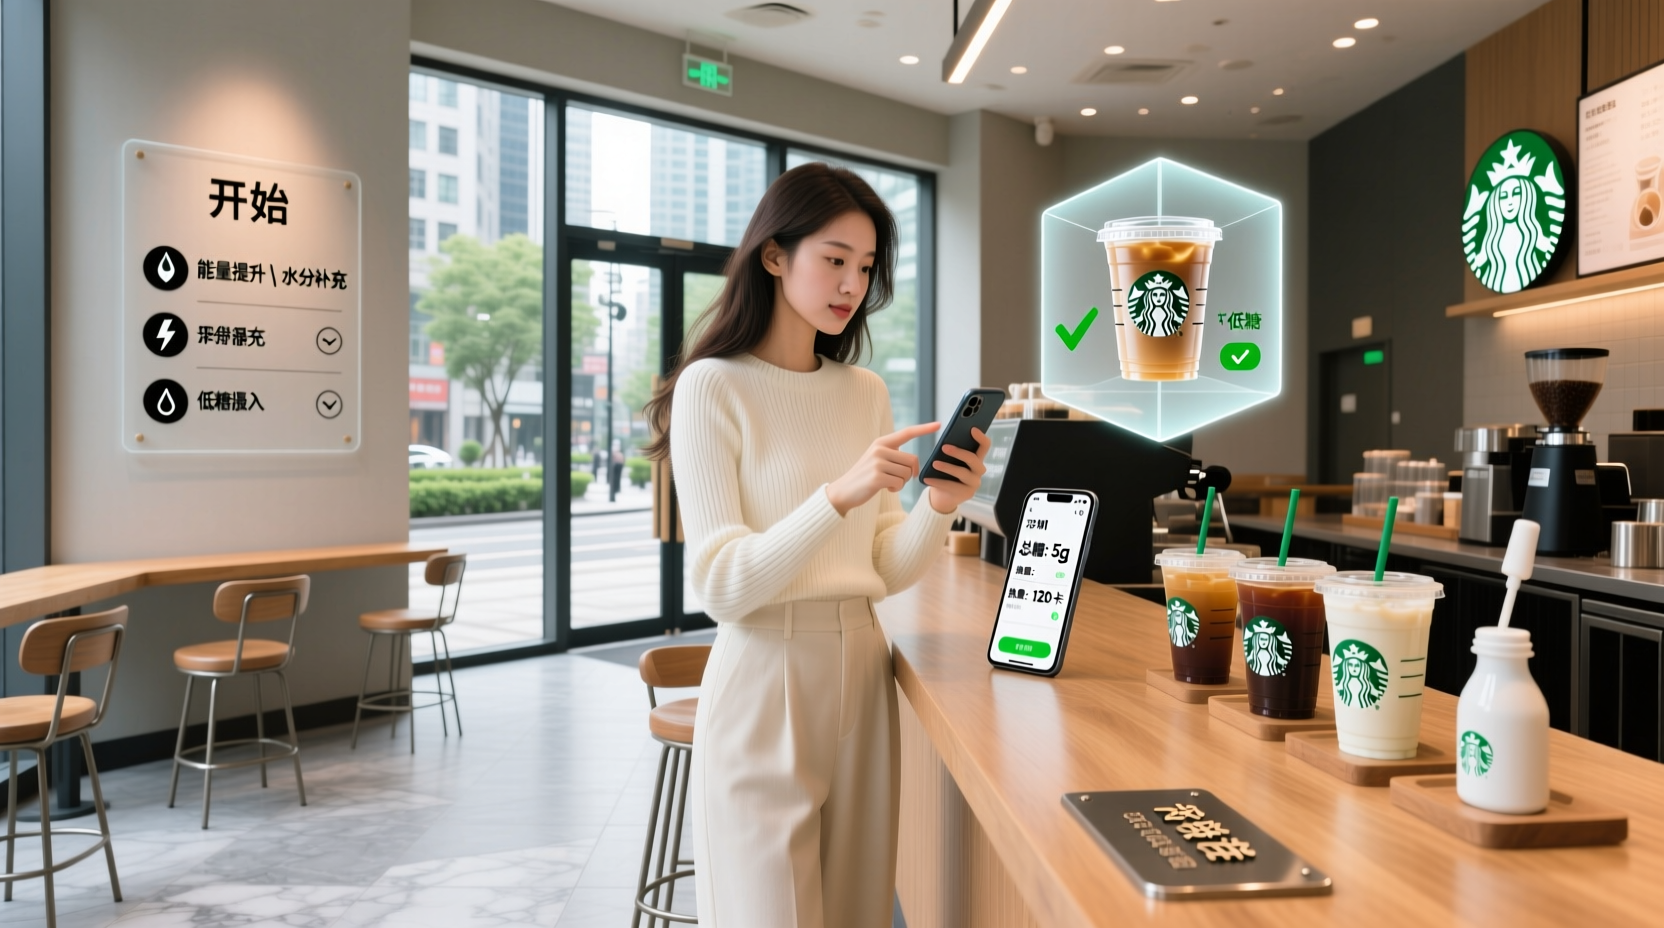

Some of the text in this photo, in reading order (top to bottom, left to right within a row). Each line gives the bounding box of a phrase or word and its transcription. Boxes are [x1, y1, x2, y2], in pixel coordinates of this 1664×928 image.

[208, 178, 289, 226] 开始
[282, 266, 348, 291] 水分补充
[1051, 543, 1070, 564] 5g
